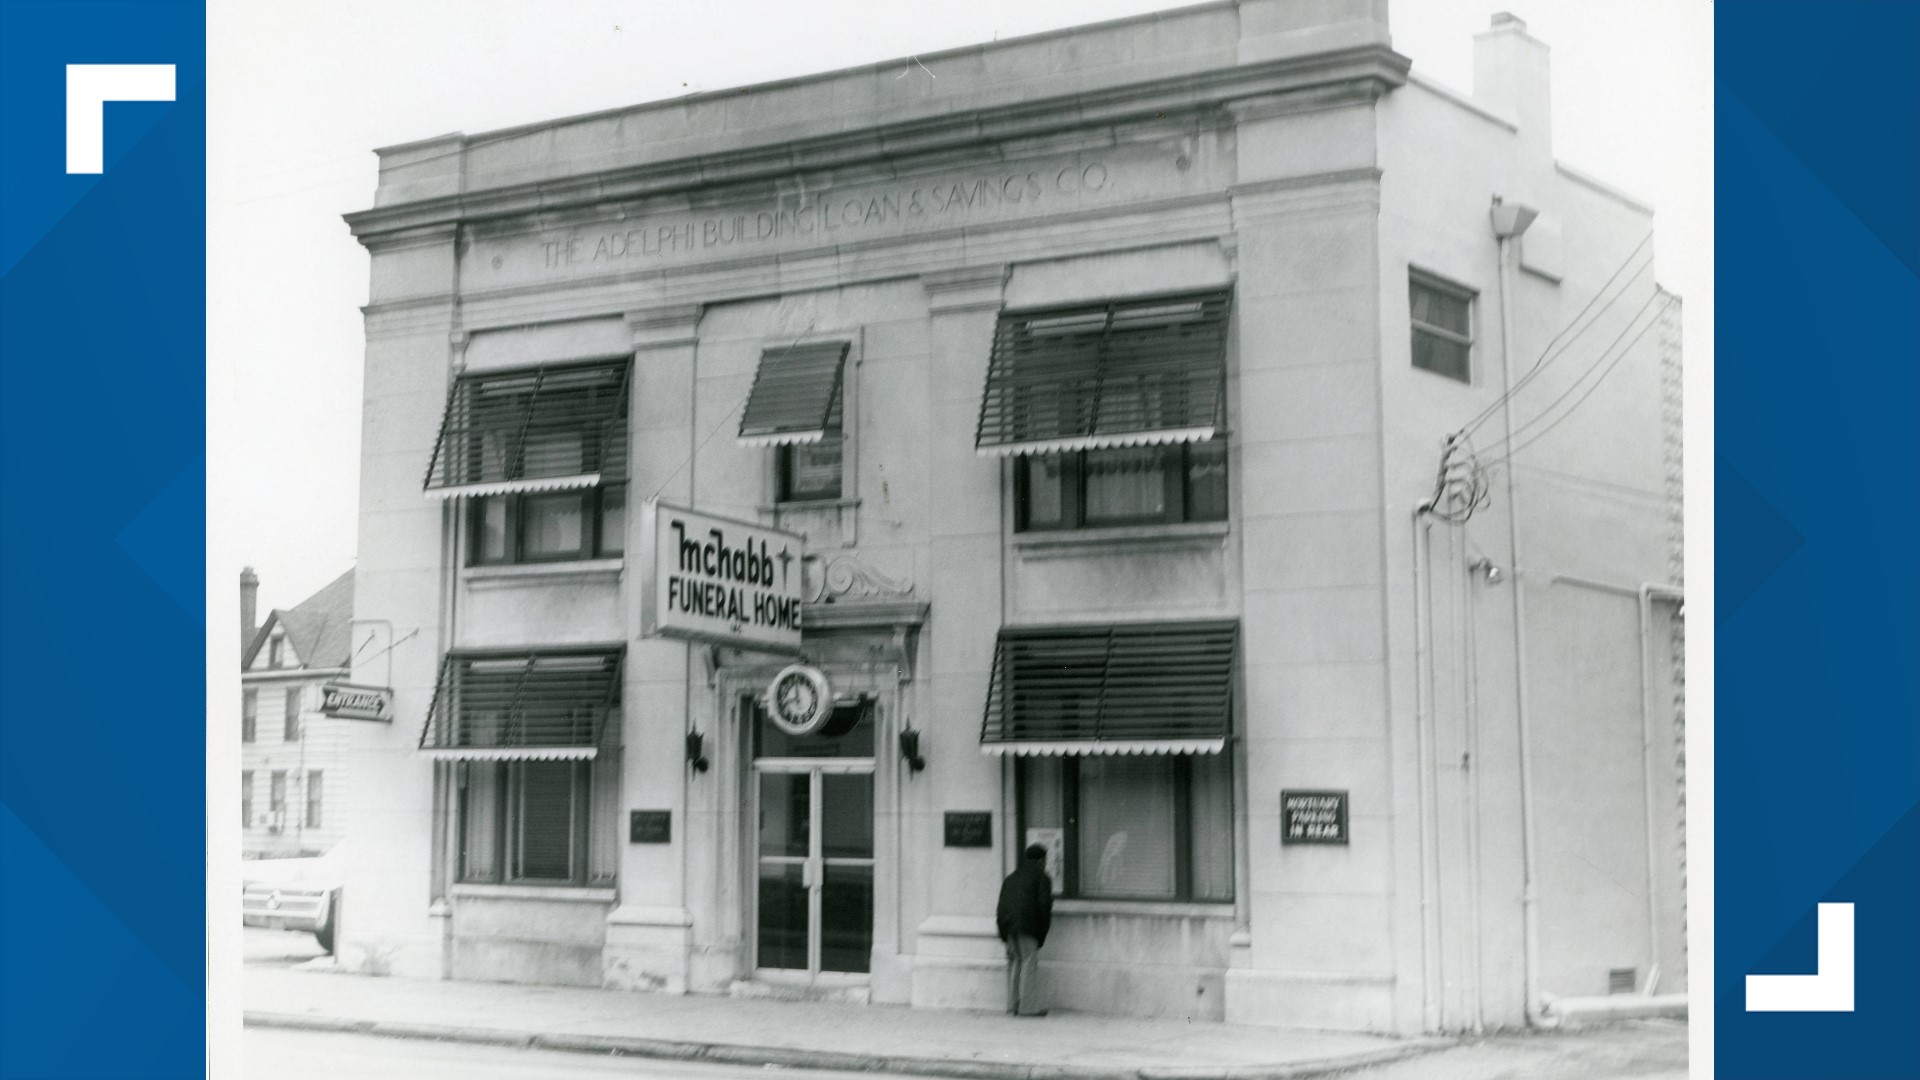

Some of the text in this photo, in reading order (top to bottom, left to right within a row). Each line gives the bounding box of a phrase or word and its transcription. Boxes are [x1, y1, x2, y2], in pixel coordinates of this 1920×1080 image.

[541, 238, 585, 269] THE
[593, 222, 695, 262] ADELPHI
[702, 205, 814, 249] BUILDING
[824, 192, 900, 231] LOAN
[908, 188, 925, 215] &
[931, 171, 1042, 213] SAVINGS
[668, 574, 801, 631] FUNERAL HOME
[326, 691, 382, 710] ENTRANCE
[1289, 823, 1339, 838] IN REAR
